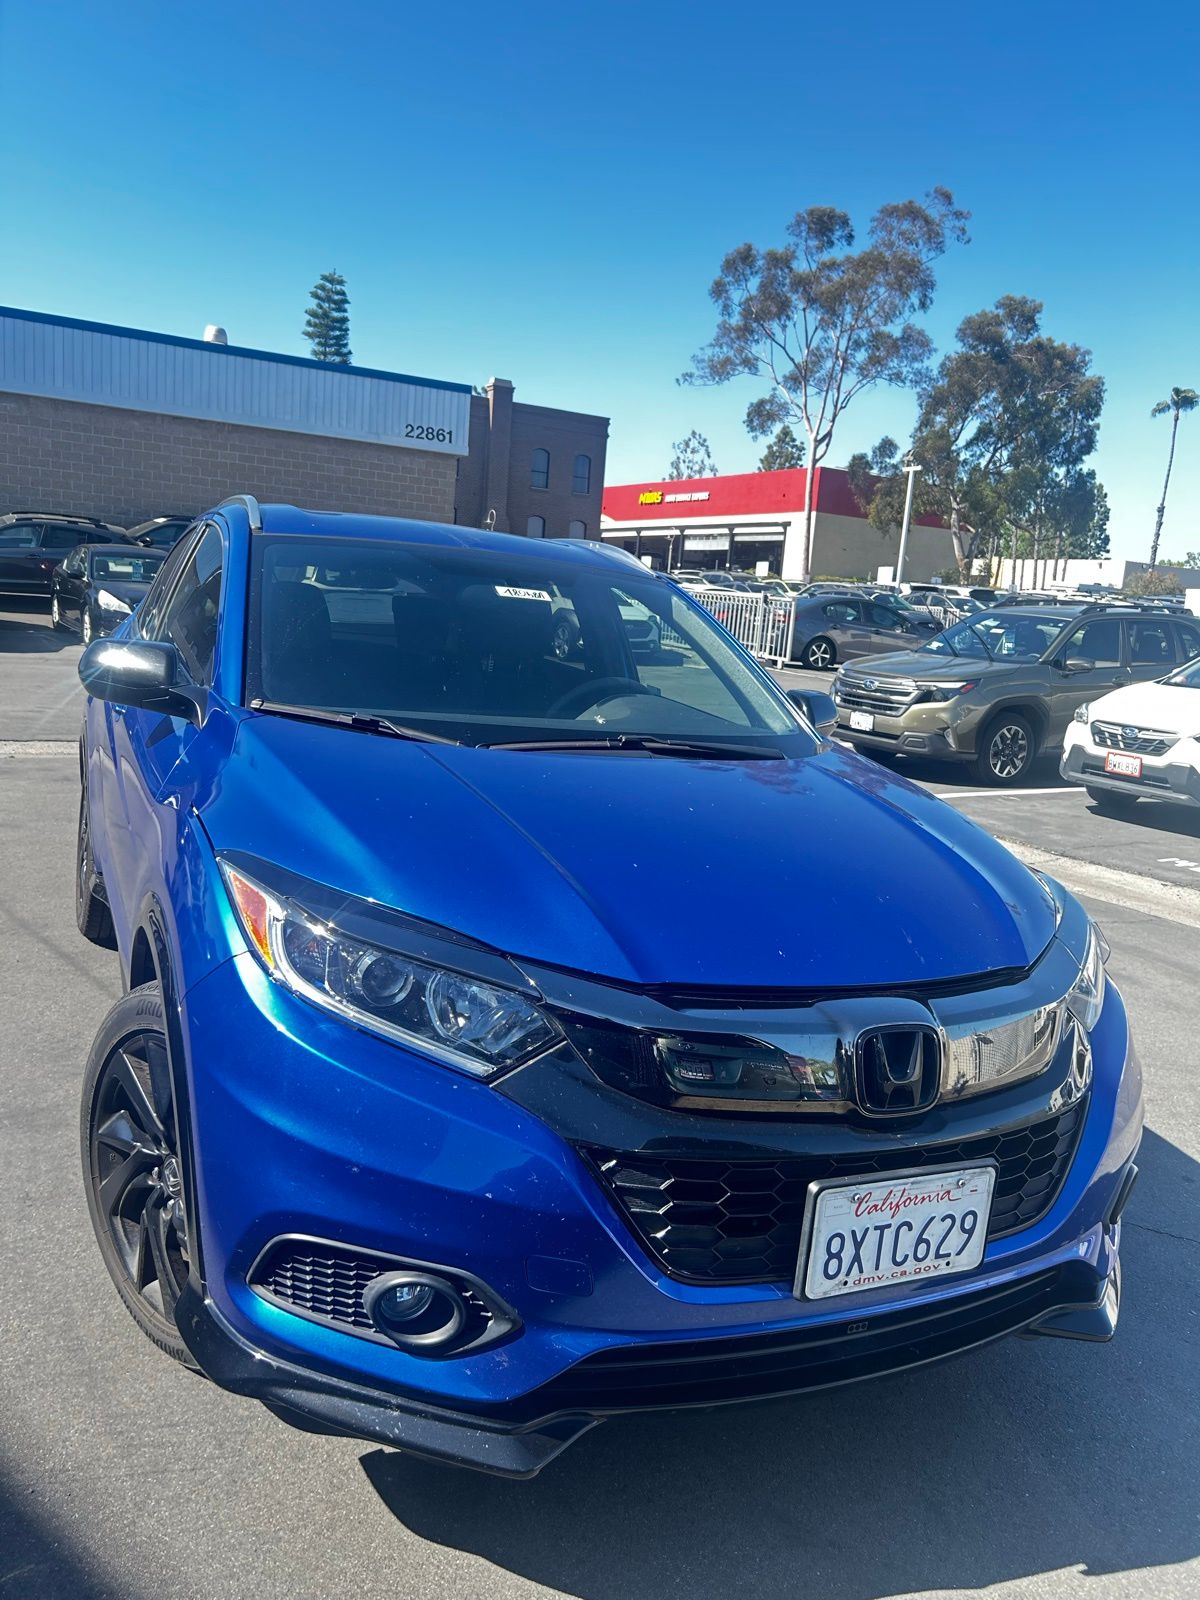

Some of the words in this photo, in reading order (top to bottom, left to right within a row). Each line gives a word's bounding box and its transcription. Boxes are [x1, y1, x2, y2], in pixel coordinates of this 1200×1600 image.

[405, 424, 453, 443] 22861
[854, 1188, 962, 1219] California
[823, 1210, 978, 1280] 8XTC629
[853, 1263, 941, 1286] dmv.ca.gov
